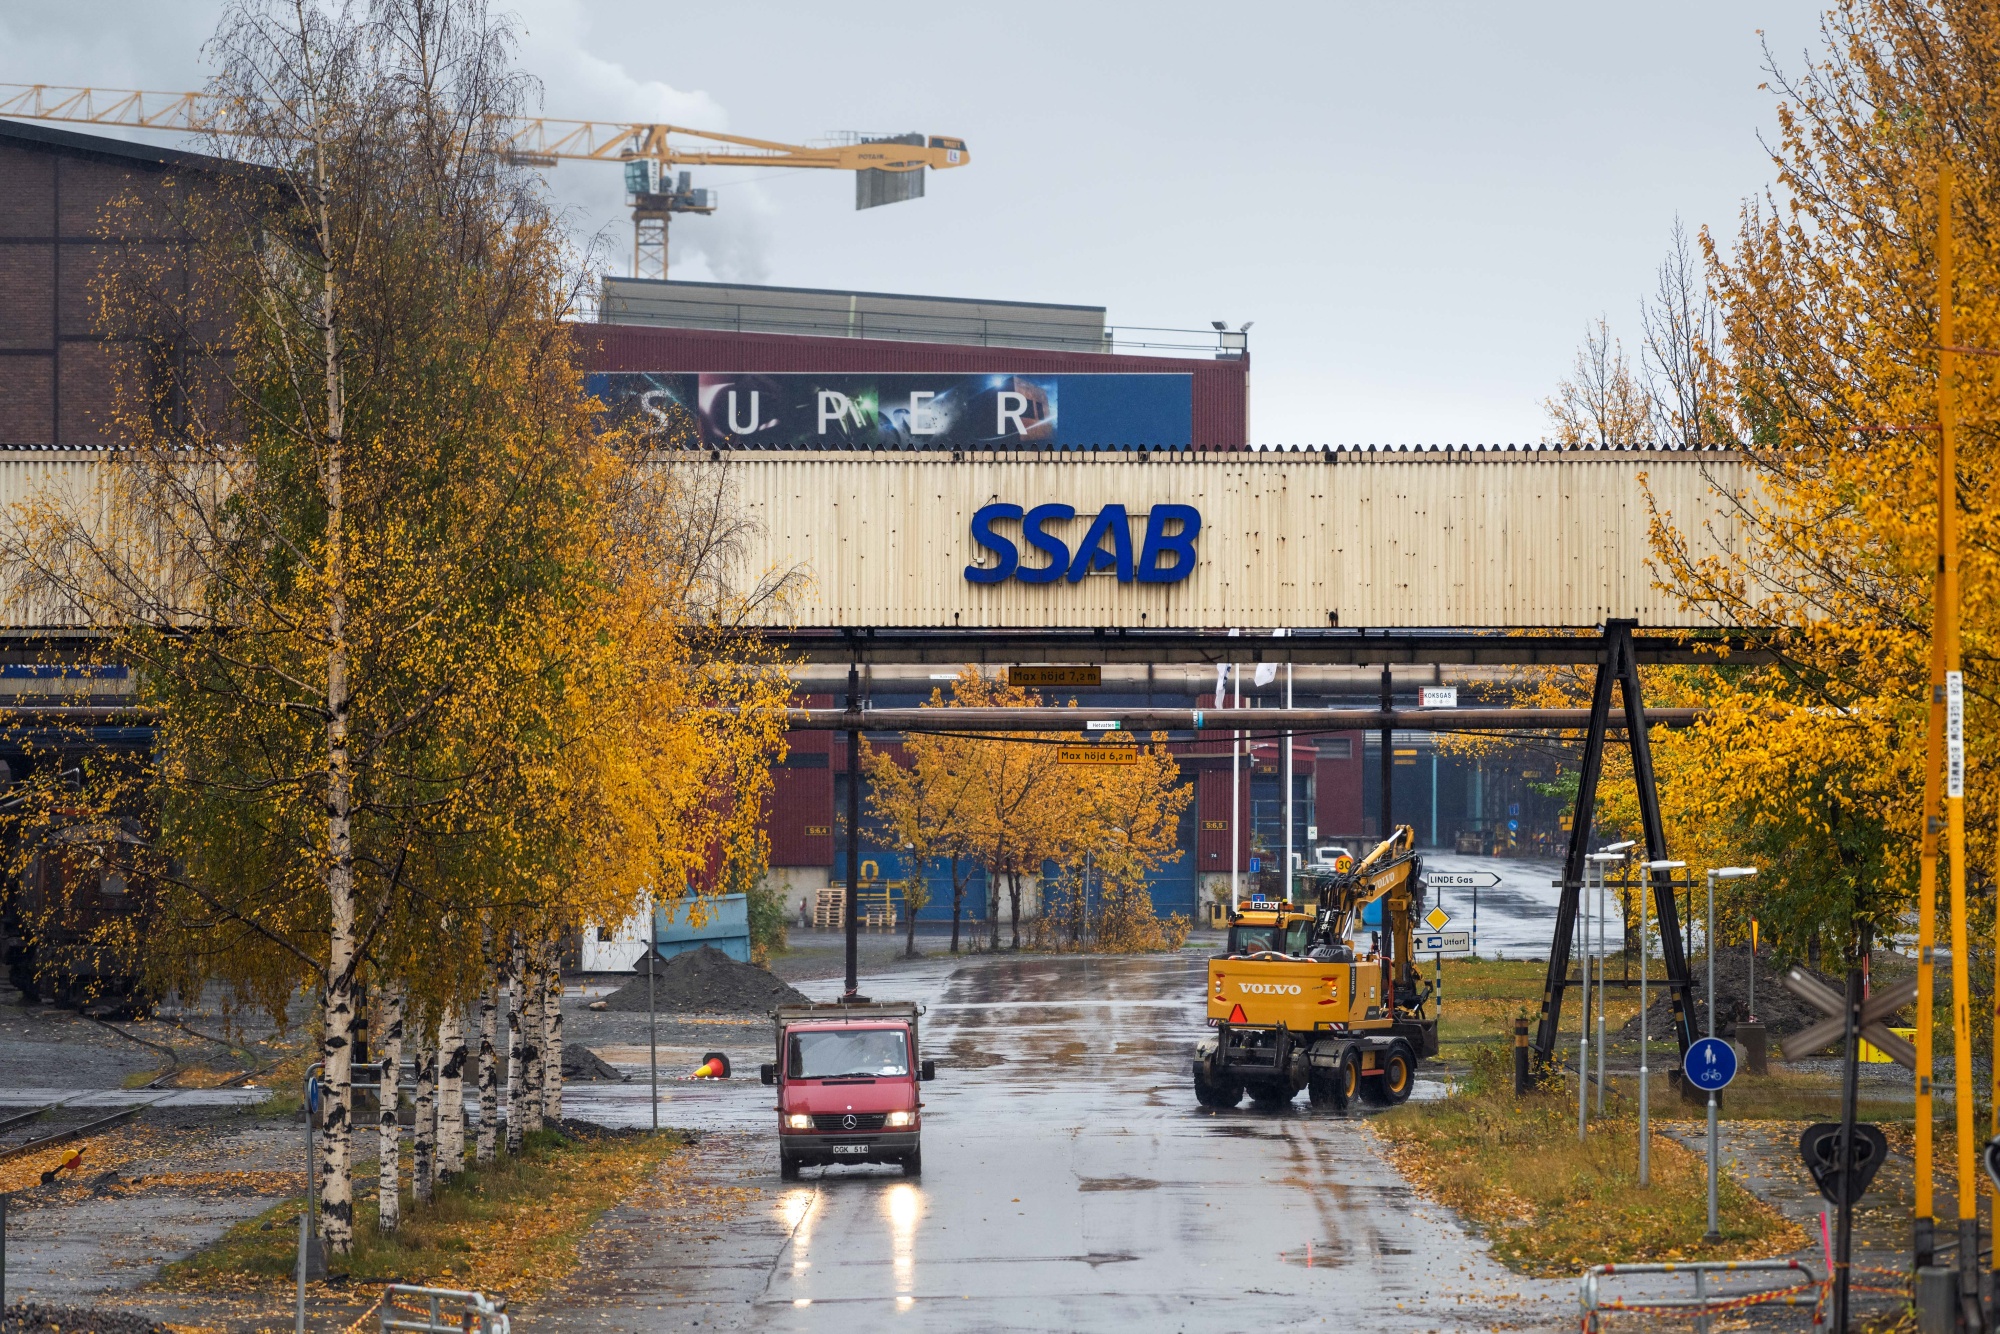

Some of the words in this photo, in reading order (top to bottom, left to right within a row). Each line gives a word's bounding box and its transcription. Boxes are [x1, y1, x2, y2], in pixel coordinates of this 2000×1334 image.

[964, 503, 1202, 583] SSAB
[1014, 672, 1036, 681] Max
[1041, 671, 1065, 682] höjd
[1061, 752, 1080, 760] Max
[1085, 752, 1106, 762] höjd
[1338, 860, 1352, 870] 30
[1372, 872, 1395, 891] VOLVO
[1430, 876, 1454, 884] LINDE
[1456, 876, 1474, 884] Gas
[1254, 902, 1277, 910] BDX
[1443, 938, 1466, 946] Utfart
[1238, 983, 1302, 995] VOLVO
